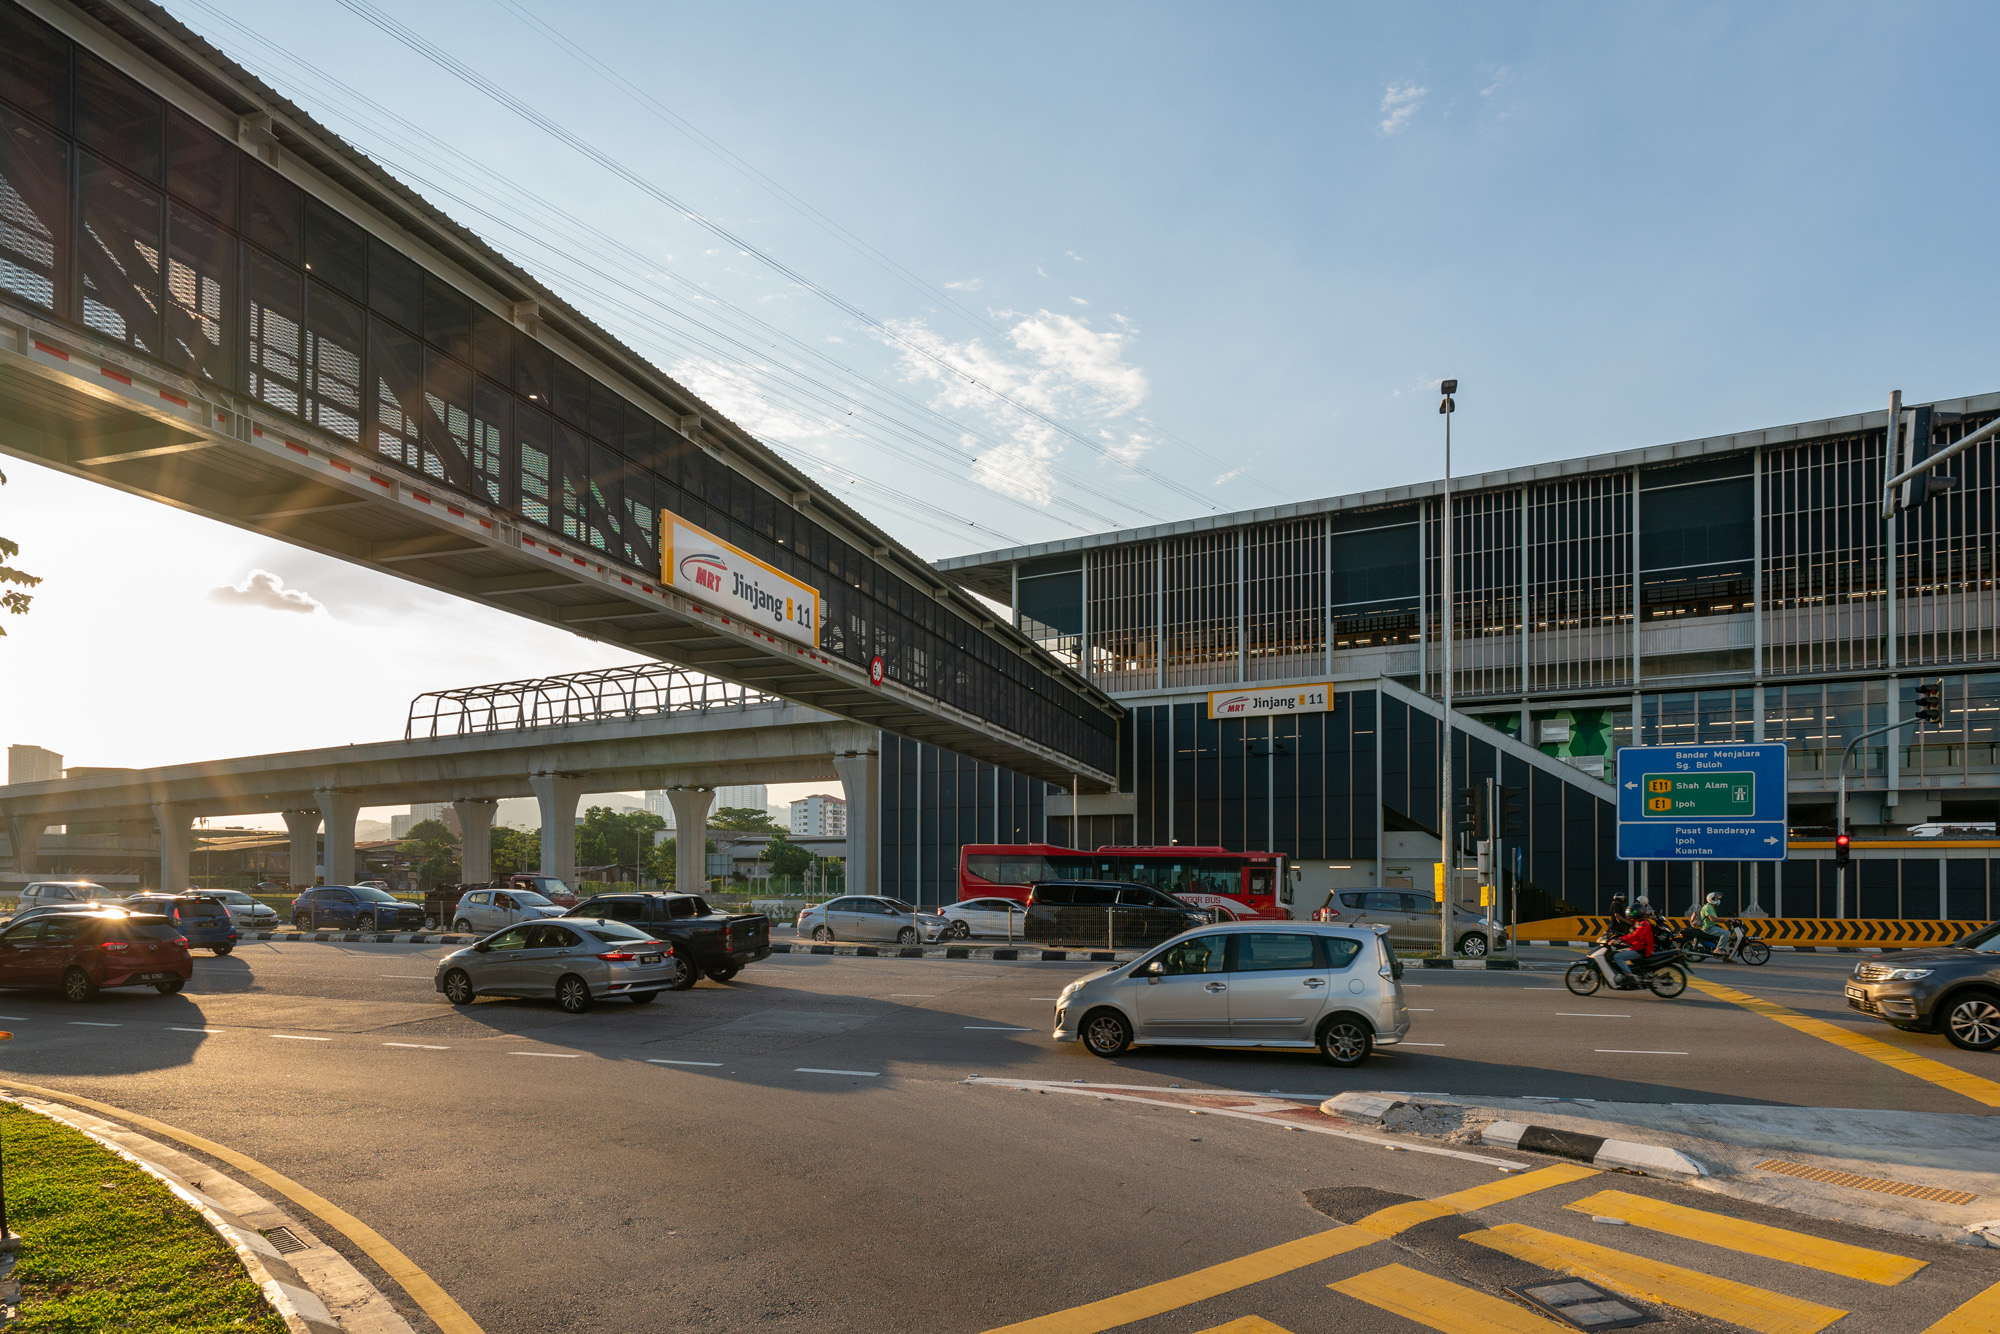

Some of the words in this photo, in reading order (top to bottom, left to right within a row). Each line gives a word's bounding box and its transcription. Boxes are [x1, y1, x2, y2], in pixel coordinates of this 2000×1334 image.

[695, 566, 722, 592] MRT
[732, 571, 783, 622] Jinjang
[796, 604, 812, 630] 11
[1227, 704, 1245, 712] MRT
[1252, 696, 1295, 709] Jinjang
[1308, 693, 1323, 704] 11
[1676, 751, 1708, 759] Bandar
[1714, 751, 1760, 759] Menjalara
[1676, 762, 1691, 770] Sg.
[1696, 761, 1722, 769] Buloh
[1653, 781, 1668, 791] E11
[1705, 781, 1728, 789] Alam
[1655, 799, 1666, 809] E1
[1675, 800, 1695, 808] Ipoh
[1707, 827, 1755, 835] Bandaraya
[1675, 837, 1695, 845] Ipoh
[1675, 847, 1713, 855] Kuantan
